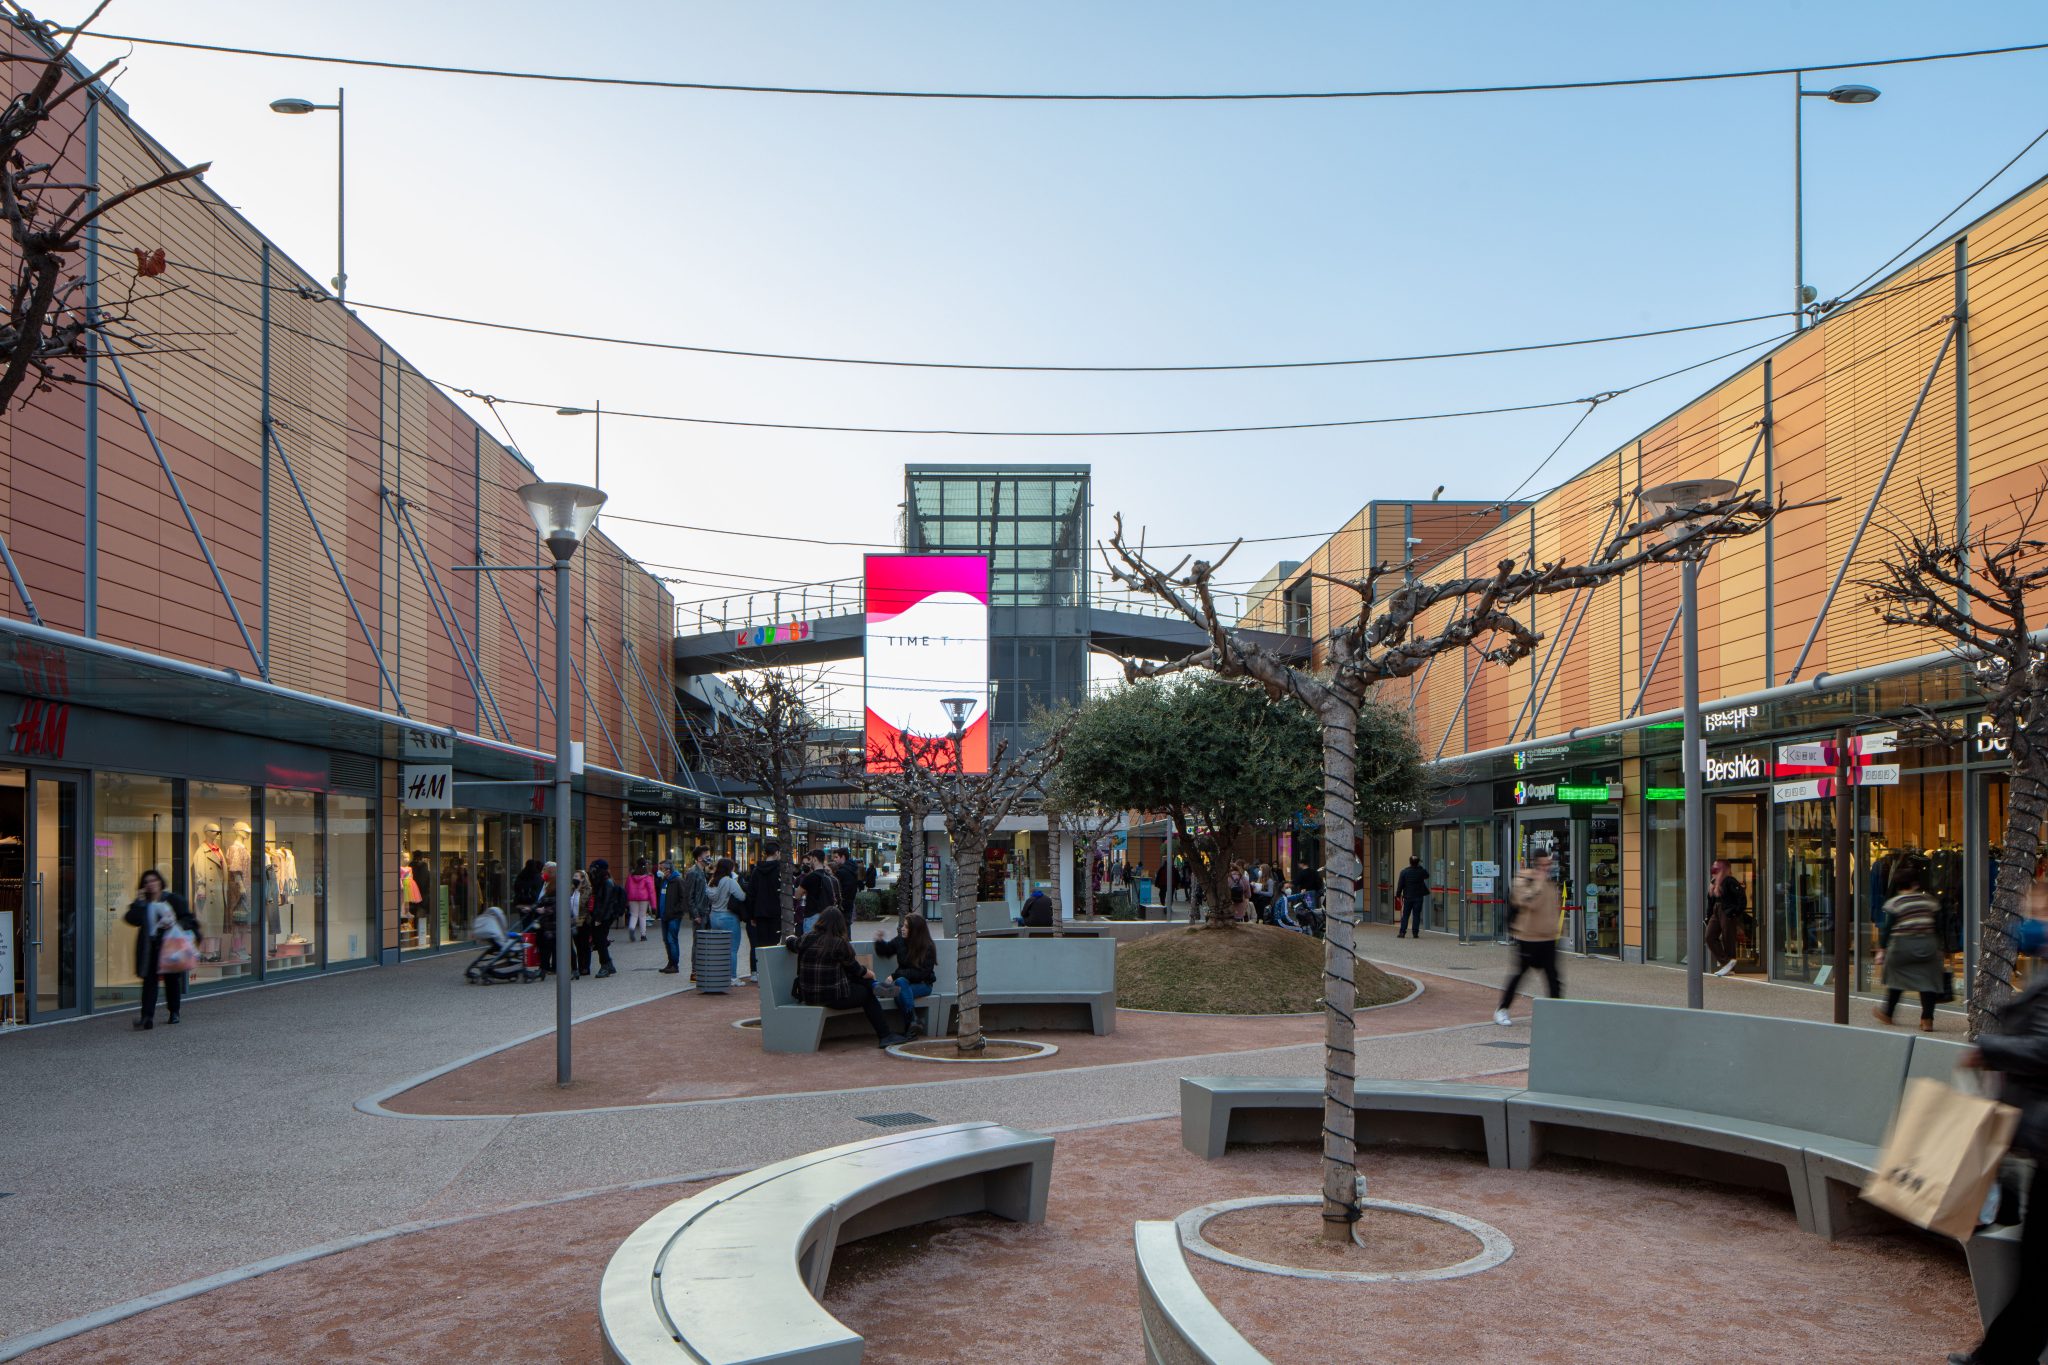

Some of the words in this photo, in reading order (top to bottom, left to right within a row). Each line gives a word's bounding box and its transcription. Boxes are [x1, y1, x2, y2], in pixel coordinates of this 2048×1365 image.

[754, 621, 809, 646] JUMBO
[888, 636, 929, 646] TIME
[14, 699, 70, 760] H&M
[1706, 754, 1760, 782] Bershka
[1808, 751, 1817, 761] WC
[408, 773, 446, 800] H&M
[727, 820, 747, 832] BSB
